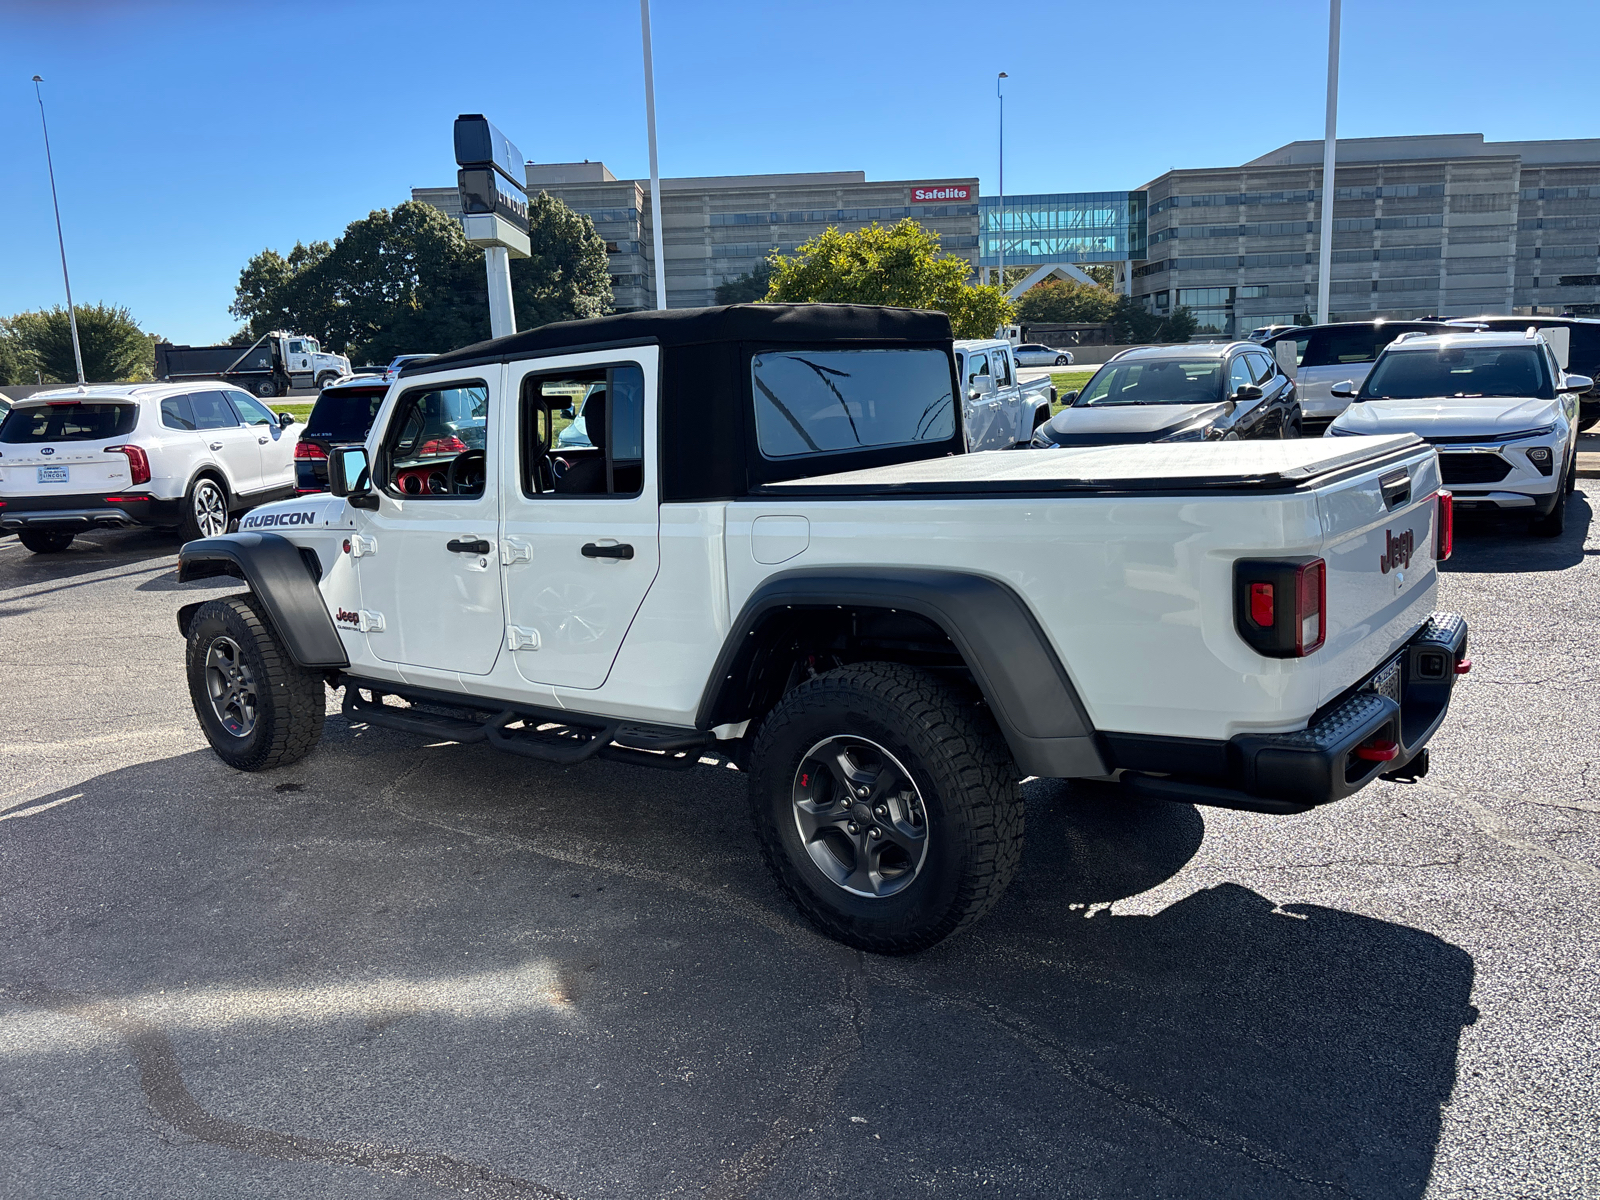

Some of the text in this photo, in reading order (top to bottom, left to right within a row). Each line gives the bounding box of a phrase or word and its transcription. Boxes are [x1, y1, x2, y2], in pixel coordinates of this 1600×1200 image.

[498, 184, 529, 221] LINCOLN
[915, 188, 967, 200] Safelite
[243, 511, 316, 528] RUBICON
[1380, 528, 1414, 575] Jeep
[336, 607, 360, 626] Jeep
